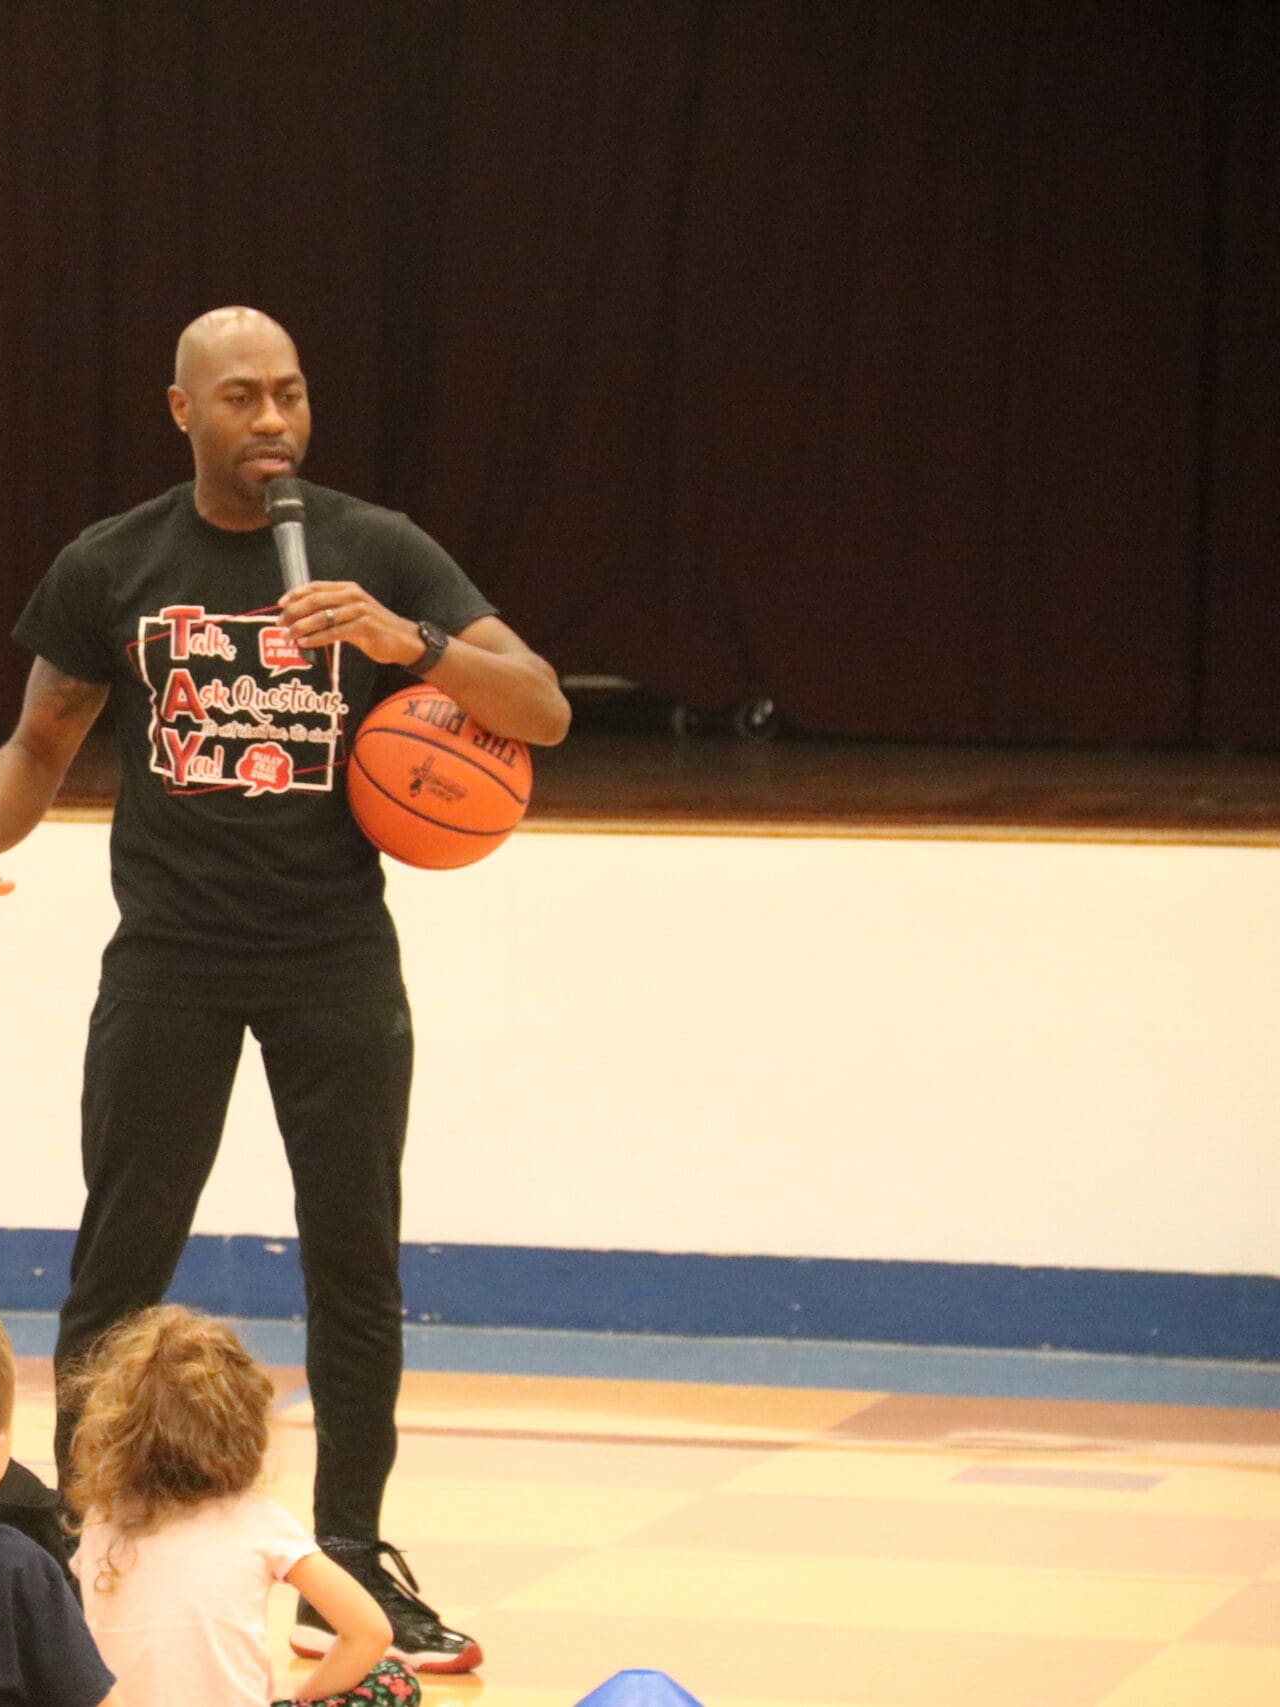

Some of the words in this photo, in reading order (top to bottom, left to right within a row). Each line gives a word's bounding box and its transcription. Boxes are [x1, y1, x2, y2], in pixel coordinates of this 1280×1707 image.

[160, 605, 237, 662] Talk.
[161, 669, 233, 723] Ask
[232, 675, 349, 722] Questions.
[402, 699, 468, 737] ROCK
[161, 727, 225, 786] You!
[251, 751, 285, 766] BULLY
